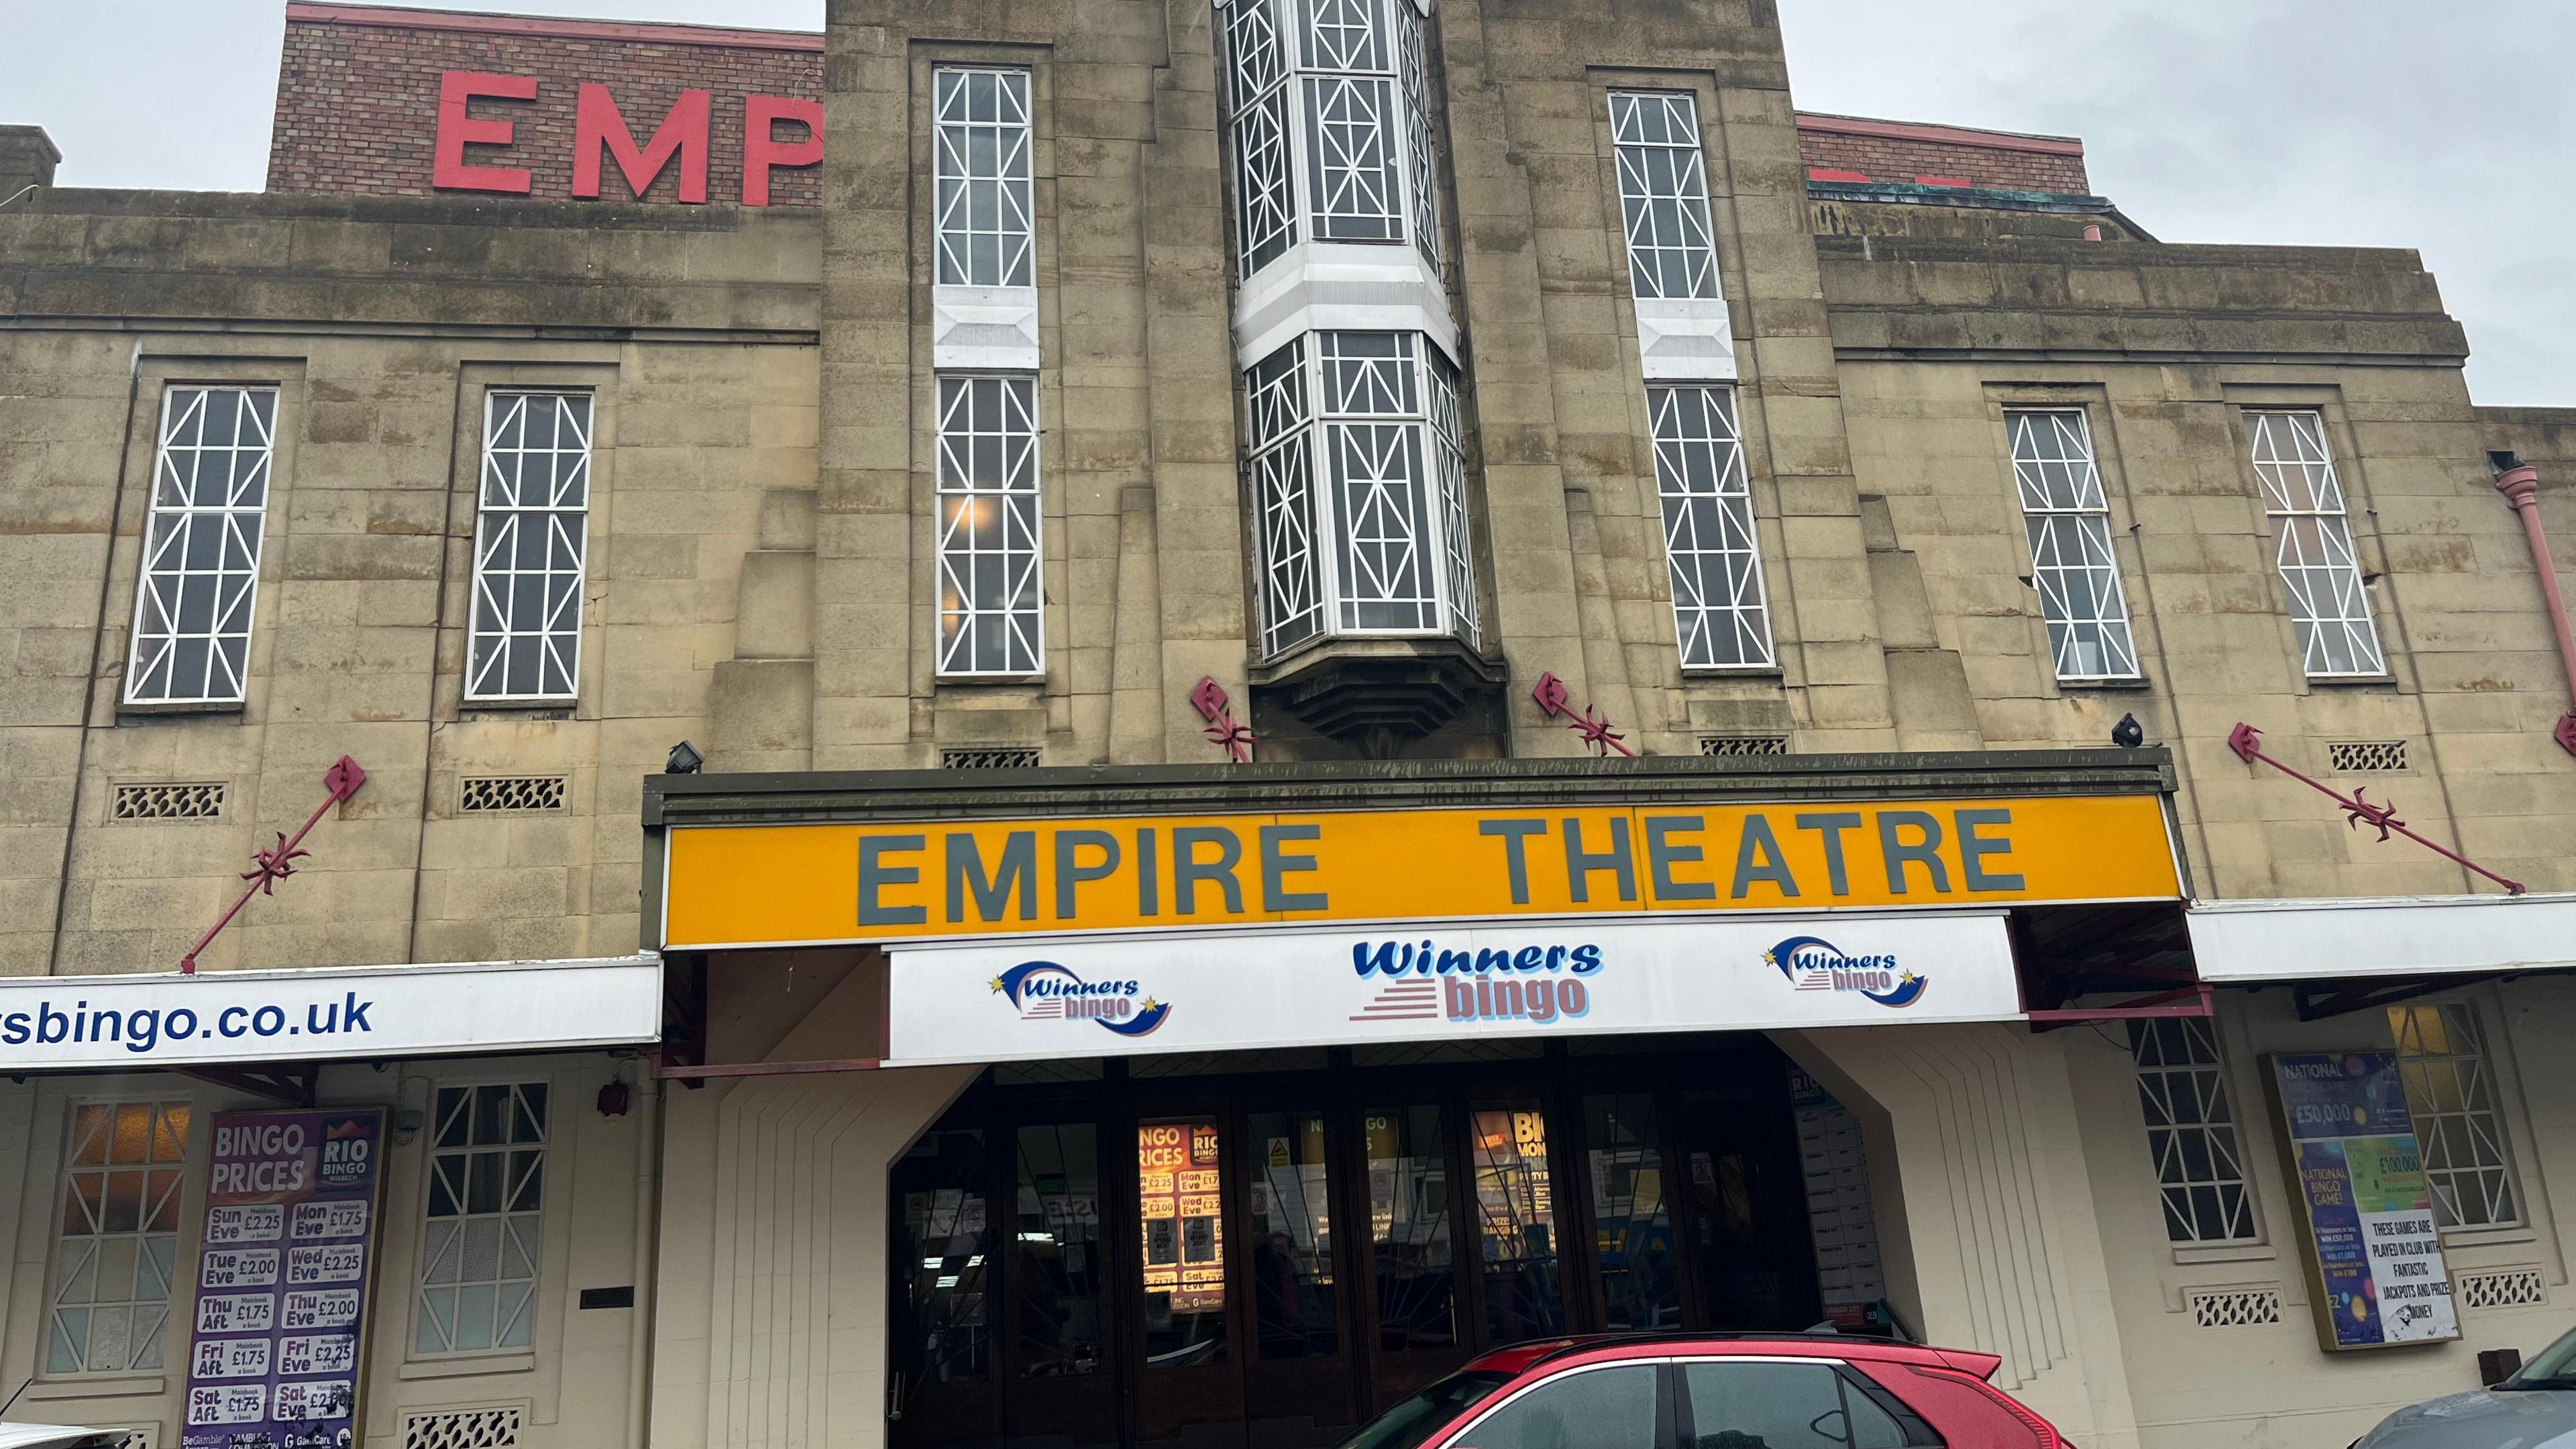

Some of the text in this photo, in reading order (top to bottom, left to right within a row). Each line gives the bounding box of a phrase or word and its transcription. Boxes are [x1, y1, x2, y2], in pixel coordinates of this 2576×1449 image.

[858, 808, 2025, 926] EMPIRE THEATRE
[1353, 939, 1601, 976] Winners
[1793, 952, 1896, 971] Winners
[1024, 977, 1139, 997] Winners
[1831, 969, 1891, 993] bingo
[1446, 973, 1587, 1021] bingo
[1065, 994, 1130, 1020] bingo
[2285, 1062, 2343, 1079] NATIONAL
[1794, 1088, 1821, 1100] BINGO
[2297, 1104, 2351, 1126] £50,000
[1513, 1112, 1544, 1142] BI
[215, 1124, 305, 1157] BINGO
[325, 1139, 368, 1163] RIO
[323, 1162, 366, 1175] BINGO
[2379, 1155, 2420, 1174] £100,000
[211, 1160, 305, 1193] PRICES
[329, 1174, 358, 1182] WISBECH
[1181, 1173, 1200, 1181] Mon
[2302, 1167, 2347, 1181] NATIONAL
[2312, 1180, 2340, 1193] BINGO
[1182, 1197, 1202, 1205] Wed
[2314, 1193, 2343, 1206] GAME!
[296, 1205, 327, 1220] Mon
[1150, 1203, 1173, 1212] £2.00
[212, 1209, 241, 1224] Sun
[244, 1215, 280, 1230] £2.25
[329, 1212, 362, 1226] £1.75
[211, 1225, 239, 1240] Eve
[296, 1222, 323, 1236] Eve
[2372, 1220, 2432, 1236] THESE GAMES ARE
[2372, 1240, 2441, 1258] PLAYED IN CLUB WITH
[208, 1253, 236, 1268] Tue
[291, 1249, 323, 1265] Wed
[323, 1256, 359, 1271] £2.25
[239, 1260, 276, 1275] £2.00
[291, 1267, 319, 1281] Eve
[2393, 1262, 2428, 1277] FANTASTIC
[205, 1270, 234, 1285] Eve
[2383, 1282, 2451, 1300] JACKPOTS AND PRIZE
[203, 1299, 232, 1313] Thu
[289, 1295, 317, 1309] Thu
[319, 1300, 355, 1316] £2.00
[237, 1305, 268, 1320] £1.75
[286, 1311, 315, 1326] Eve
[1825, 1307, 1847, 1315] UNDER
[2410, 1304, 2433, 1320] MONEY
[202, 1315, 228, 1330] Aft
[201, 1342, 223, 1358] Fri
[286, 1339, 309, 1356] Fri
[315, 1346, 350, 1361] £2.25
[232, 1350, 265, 1365] £1.75
[197, 1360, 223, 1375] Aft
[282, 1358, 311, 1373] Eve
[194, 1390, 221, 1405] Sat
[280, 1386, 307, 1401] Sat
[228, 1397, 260, 1412] £1.75
[278, 1403, 307, 1418] Eve
[193, 1407, 219, 1422] Aft
